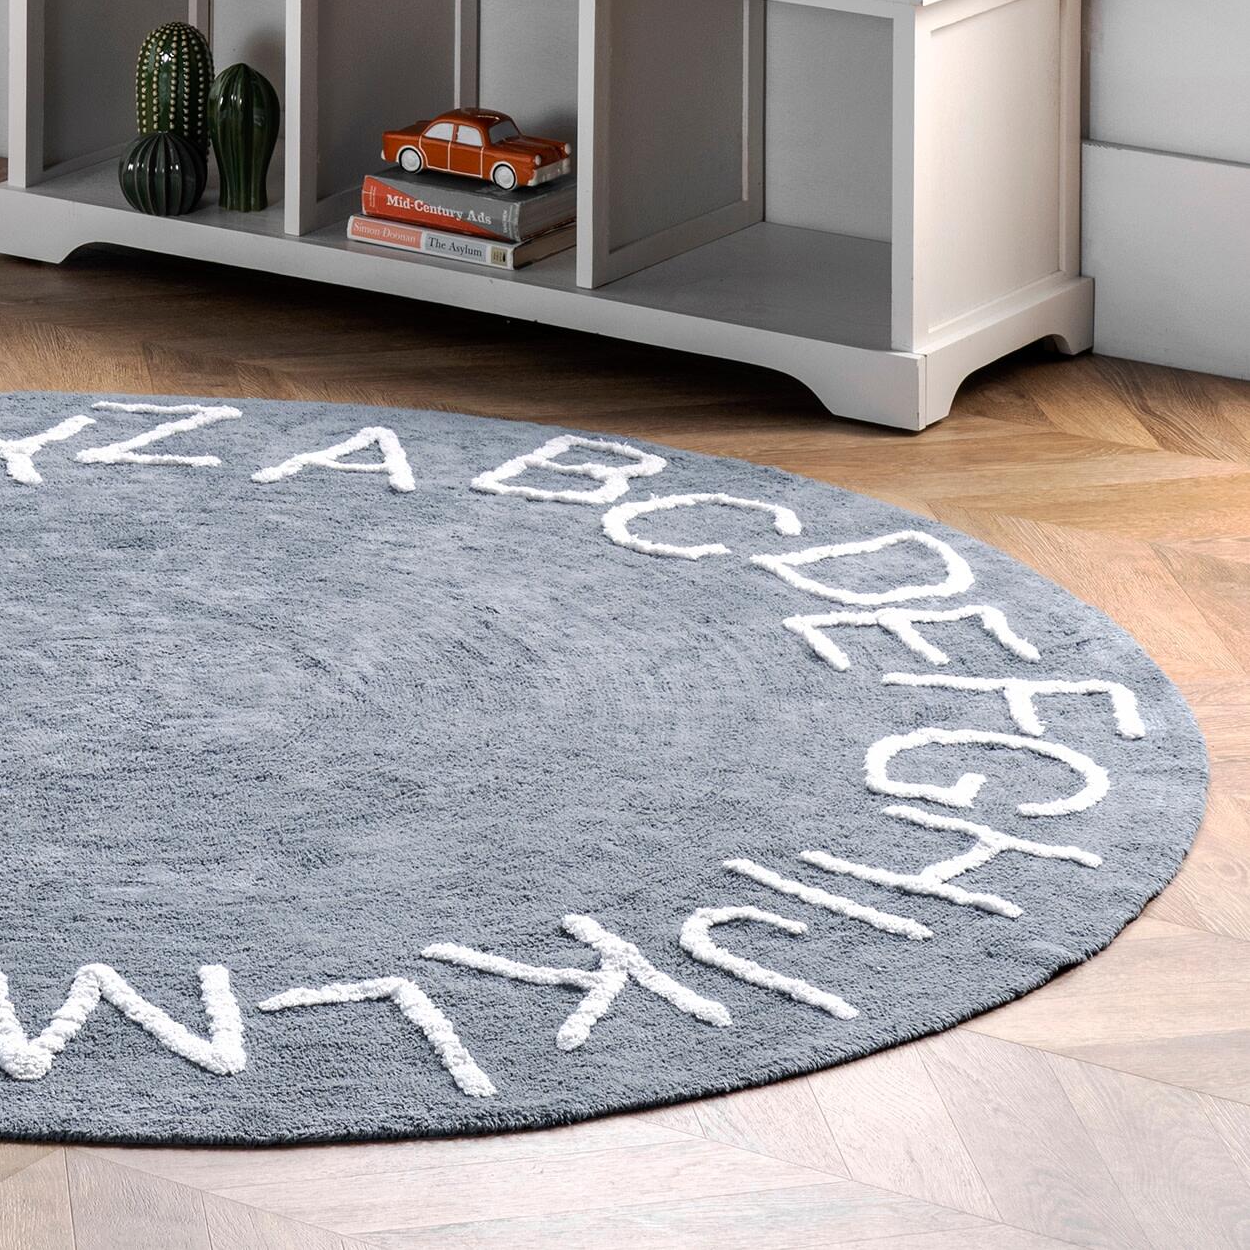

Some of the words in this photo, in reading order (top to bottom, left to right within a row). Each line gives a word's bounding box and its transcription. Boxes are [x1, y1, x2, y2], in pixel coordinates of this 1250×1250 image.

[386, 194, 463, 221] Mid-Century
[467, 210, 492, 225] Ads
[352, 222, 380, 237] Simon
[381, 228, 417, 244] Doonan
[428, 235, 447, 251] The
[448, 241, 483, 258] Asylum
